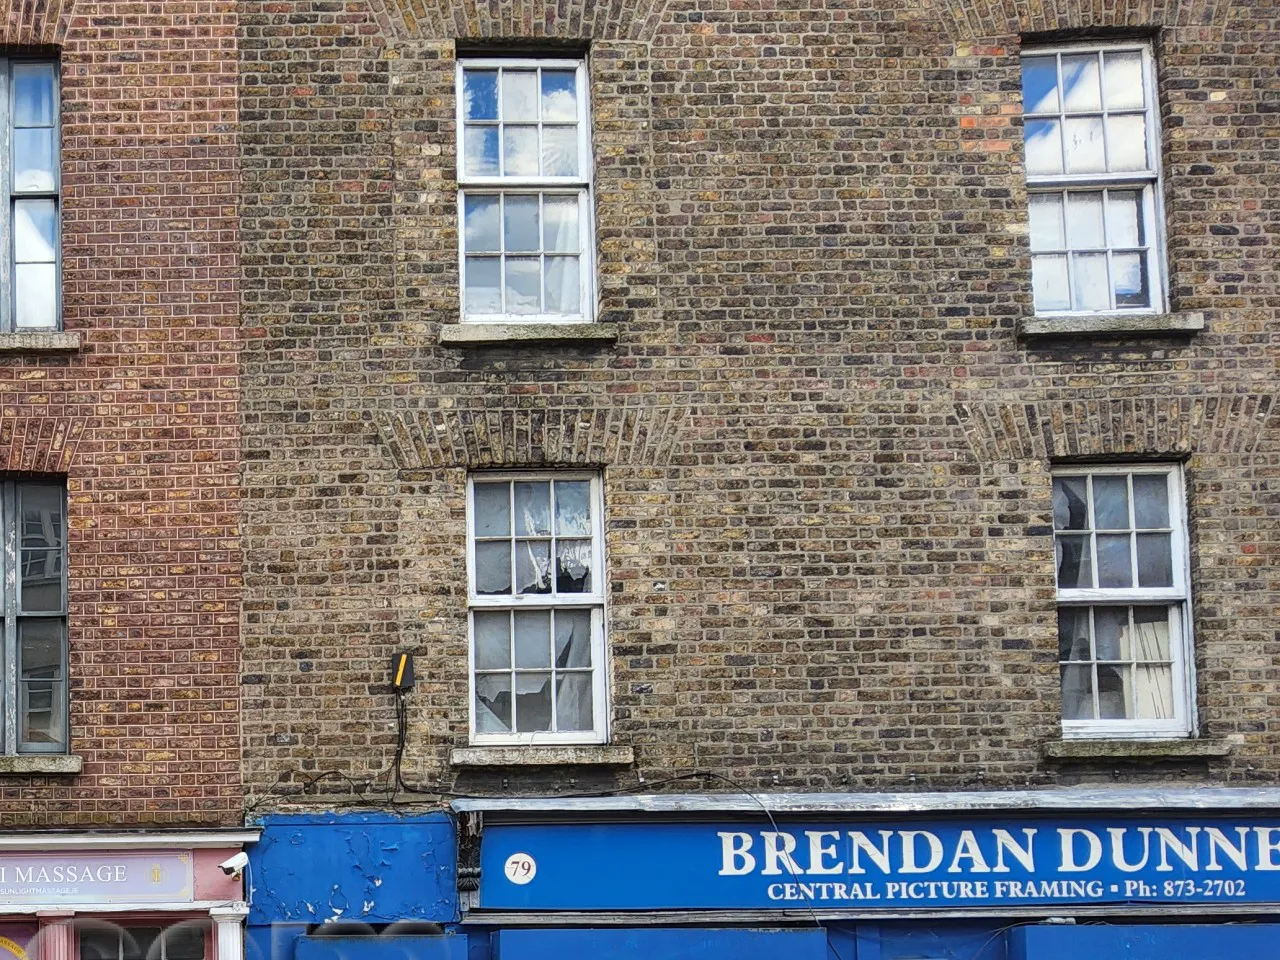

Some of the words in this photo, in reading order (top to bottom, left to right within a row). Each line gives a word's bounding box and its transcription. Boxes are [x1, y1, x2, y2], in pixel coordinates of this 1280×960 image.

[717, 828, 1038, 876] BRENDAN
[1056, 826, 1280, 873] DUNNE
[15, 865, 128, 883] MASSAGE
[510, 861, 532, 877] 79
[767, 882, 881, 901] CENTRAL
[886, 881, 989, 899] PICTURE
[994, 880, 1104, 898] FRAMING
[1124, 880, 1157, 898] Ph:
[1163, 879, 1246, 897] 873-2702
